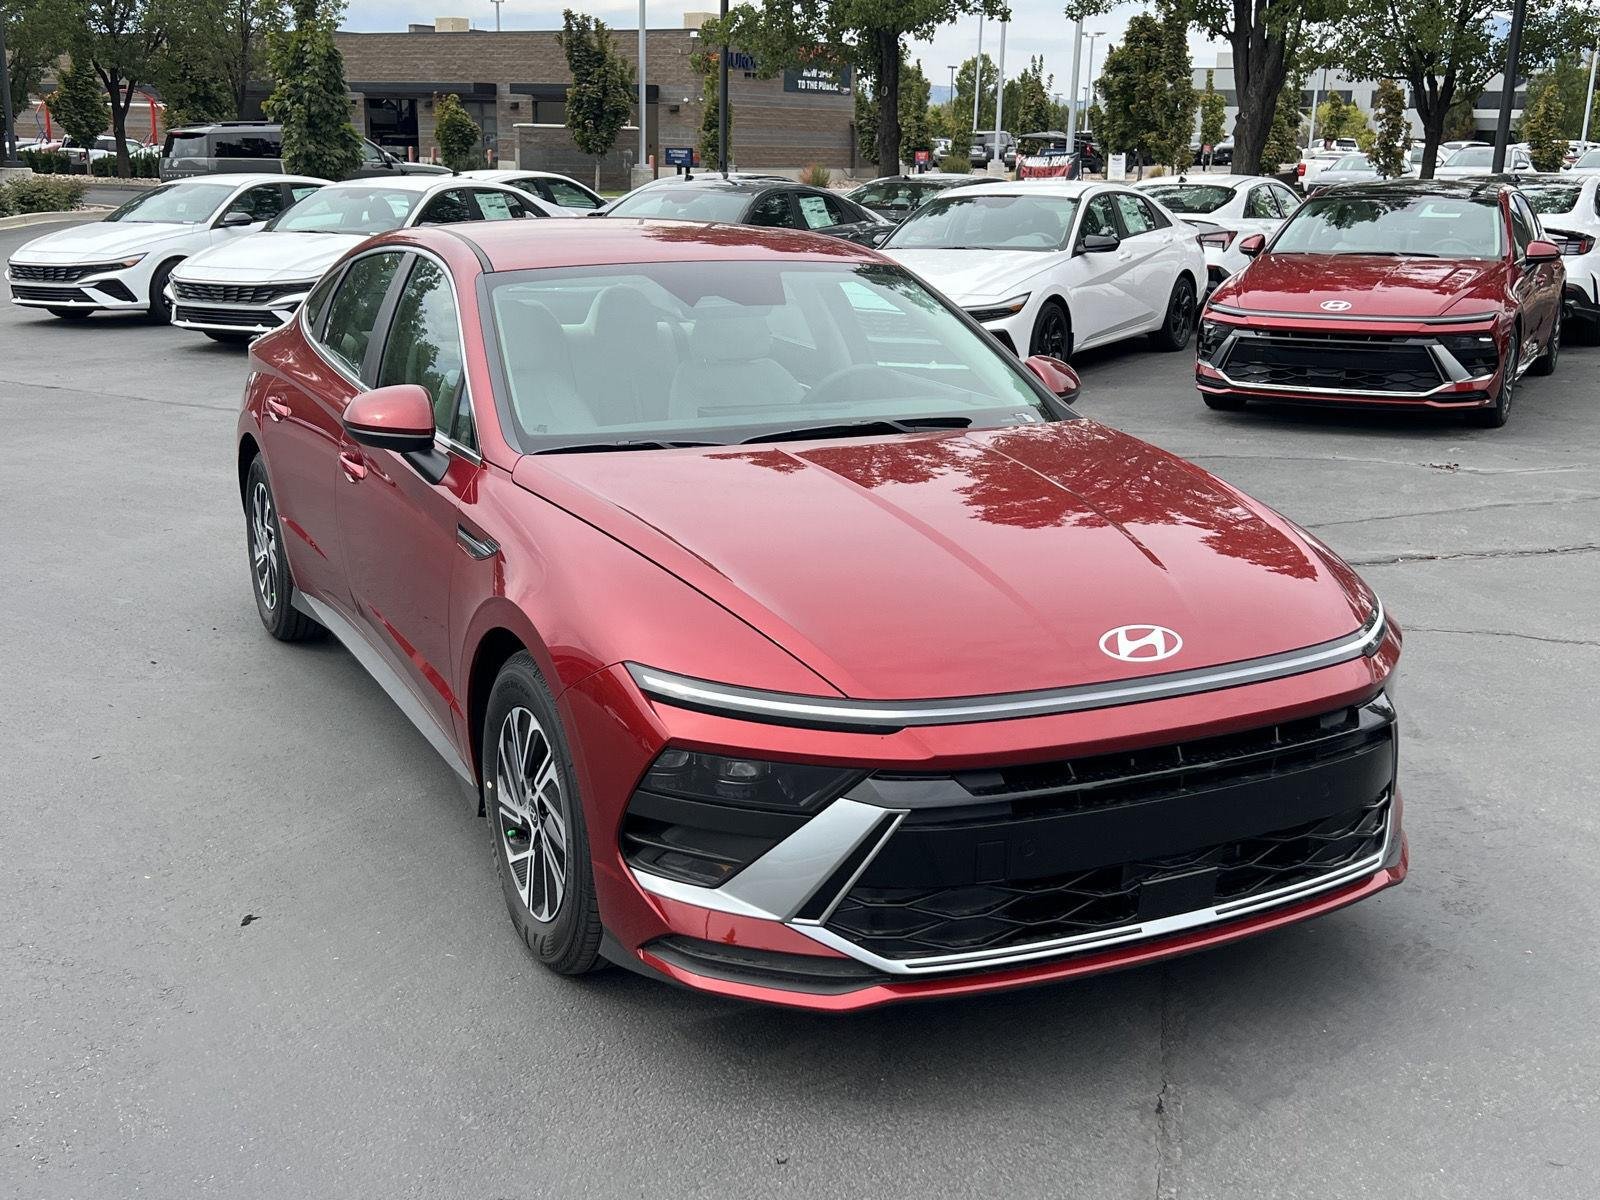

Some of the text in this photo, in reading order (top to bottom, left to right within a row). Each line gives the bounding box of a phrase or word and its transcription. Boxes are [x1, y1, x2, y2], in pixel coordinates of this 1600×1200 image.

[797, 80, 806, 89] TO
[806, 80, 818, 90] THE
[818, 80, 839, 91] PUBLIC
